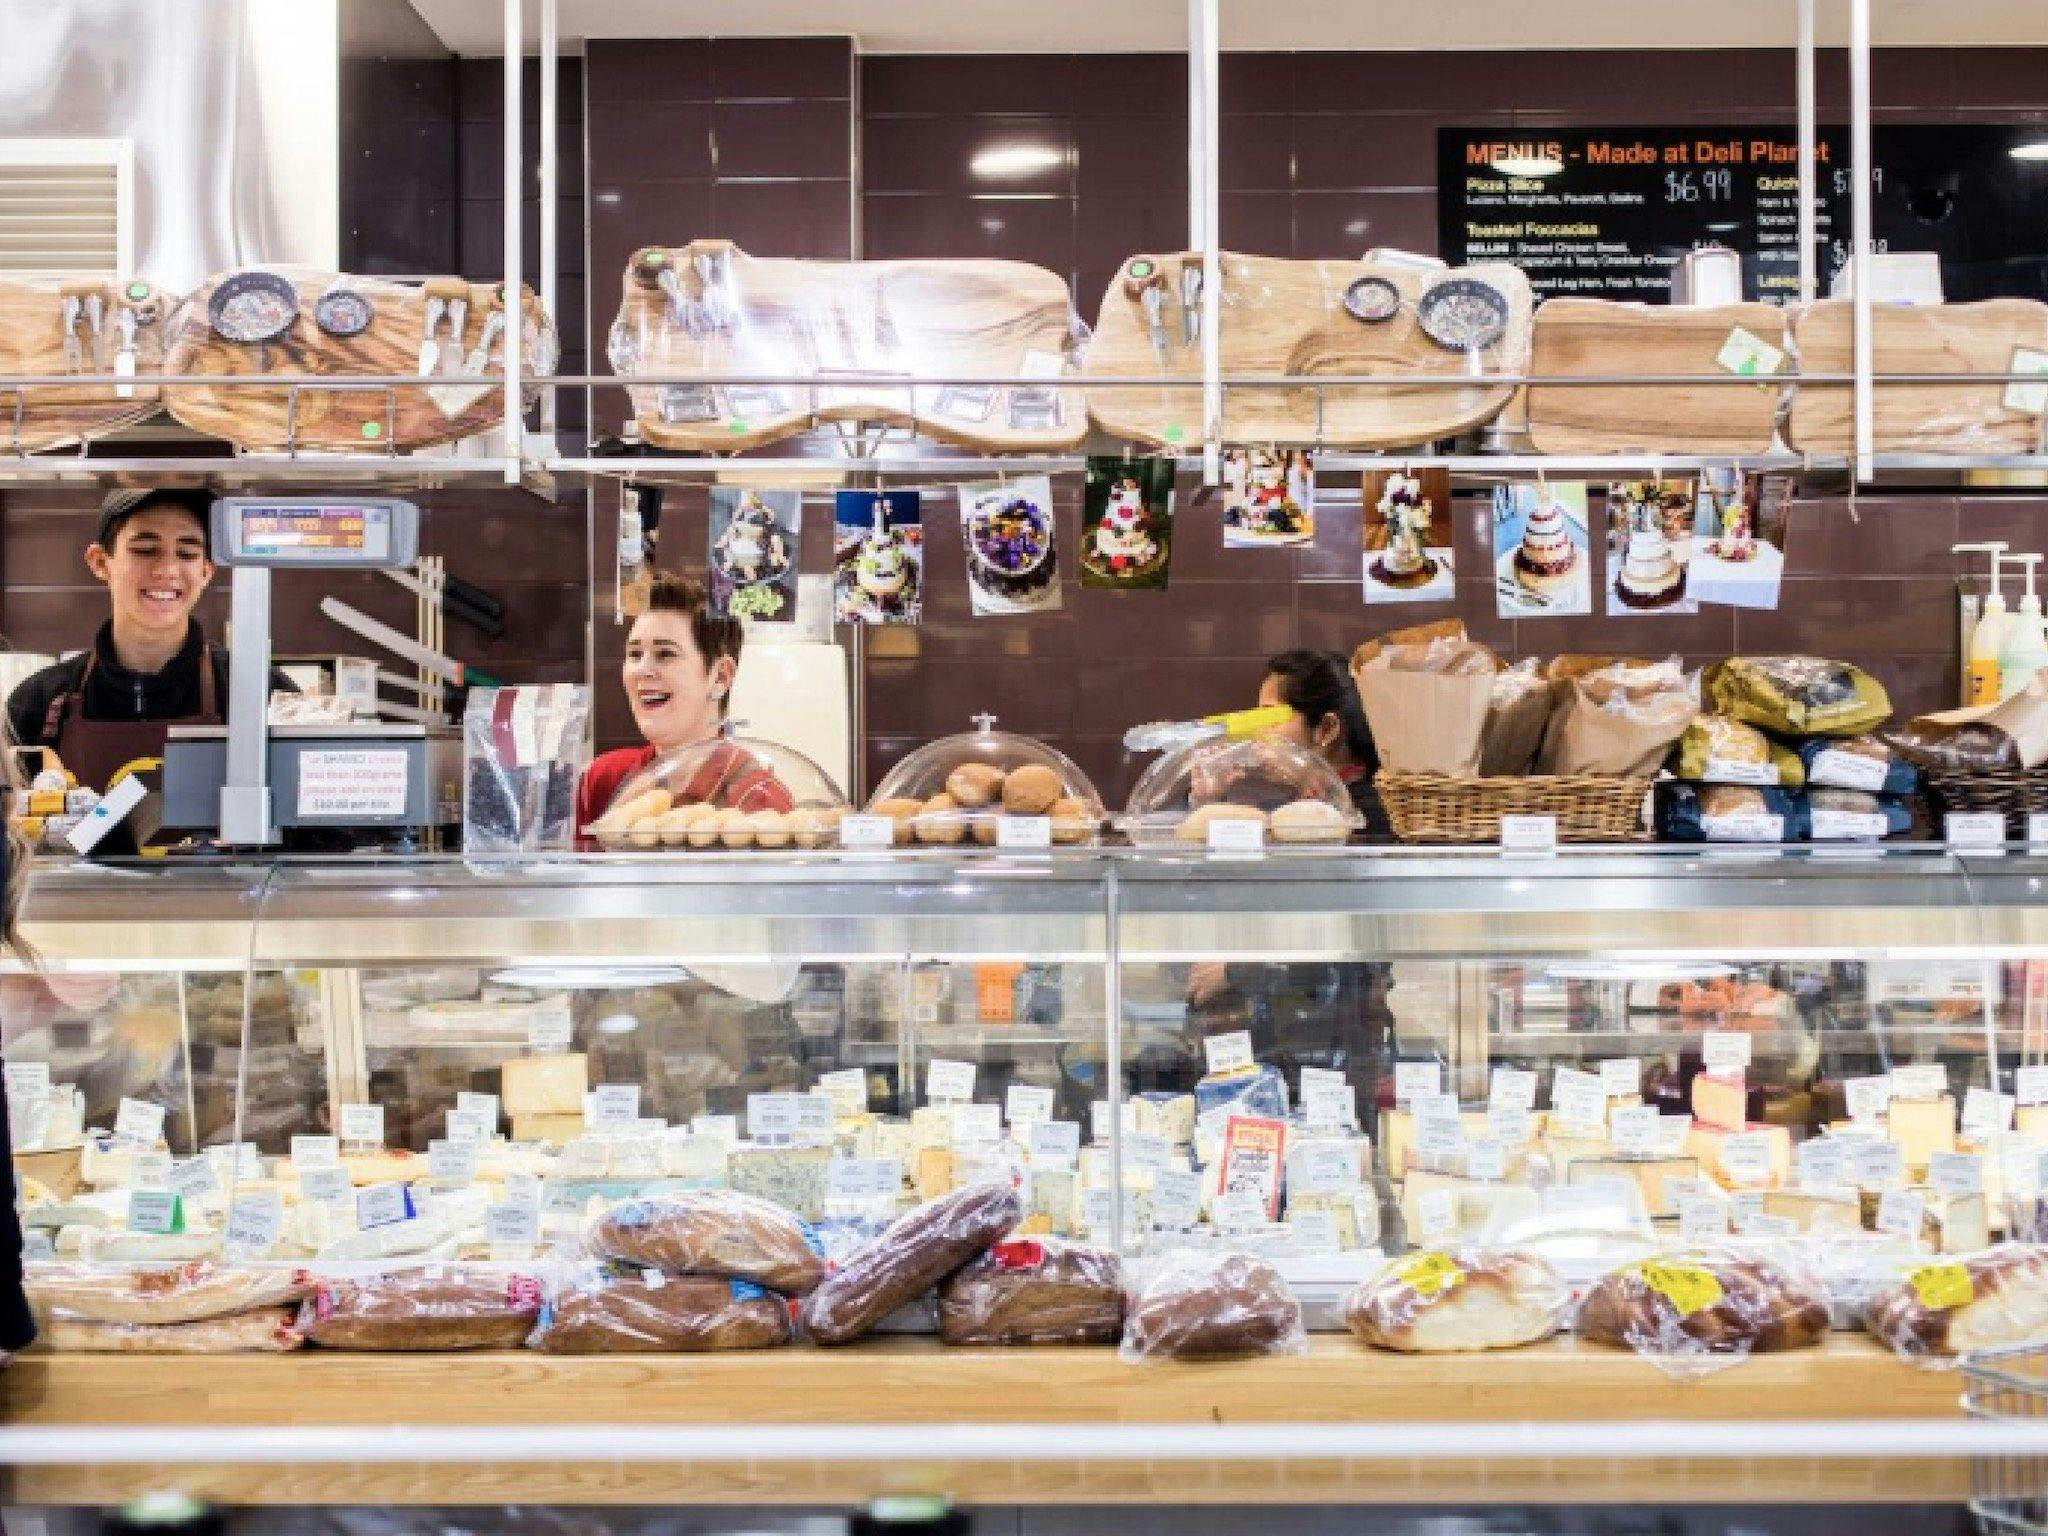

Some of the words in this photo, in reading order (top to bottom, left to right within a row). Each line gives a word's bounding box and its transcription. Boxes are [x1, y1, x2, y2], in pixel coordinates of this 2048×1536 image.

[1466, 141, 1562, 164] MENUS
[1587, 141, 1656, 164] Made
[1664, 141, 1687, 164] at
[1694, 141, 1742, 164] Deli
[1757, 176, 1798, 190] Quich
